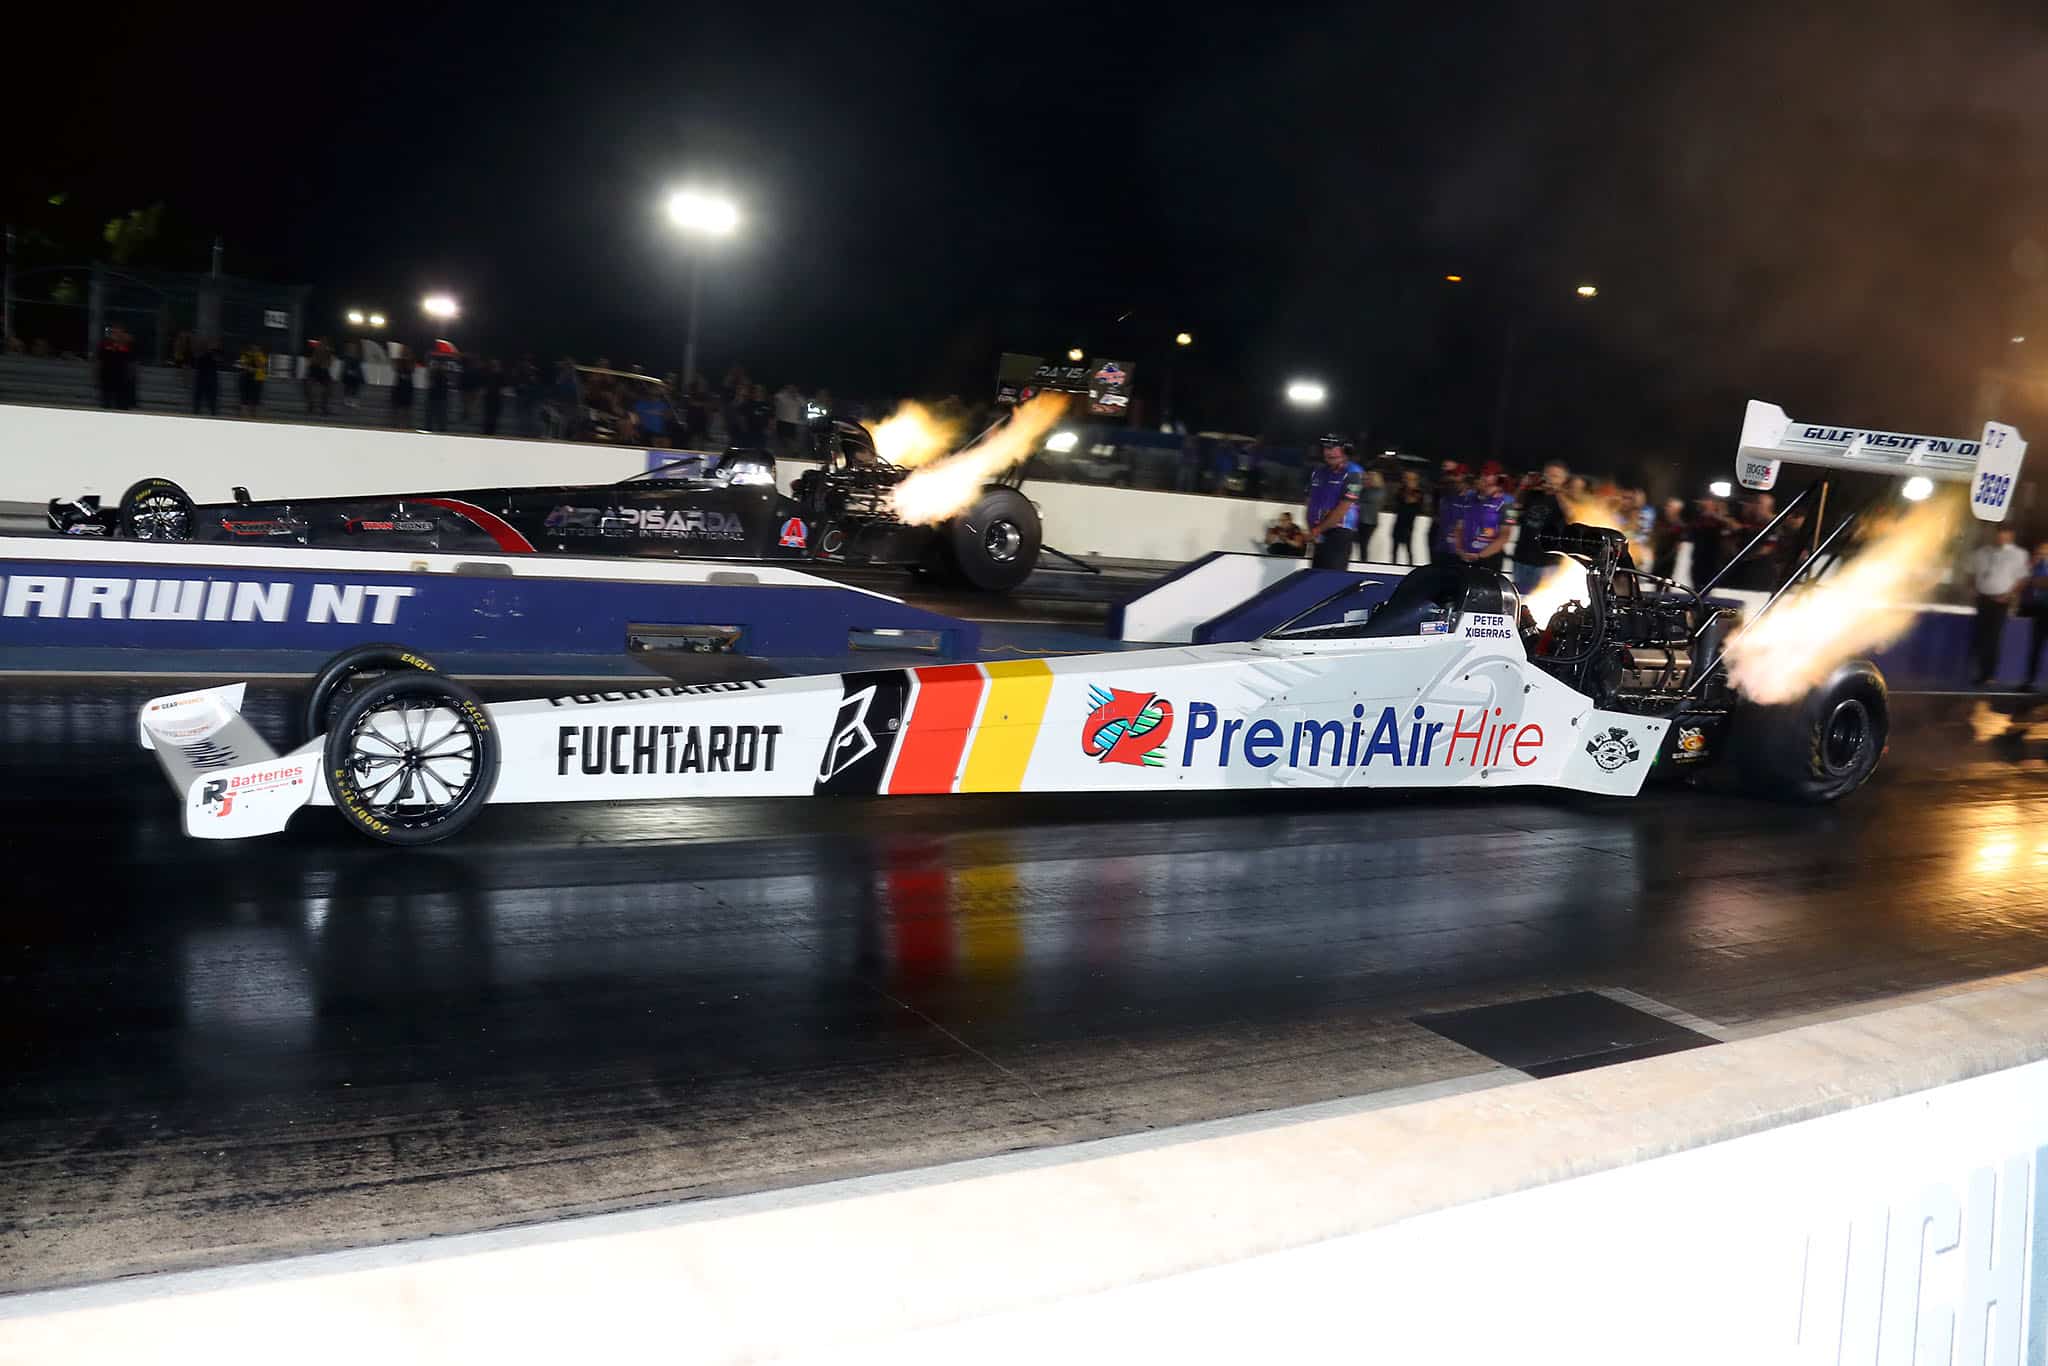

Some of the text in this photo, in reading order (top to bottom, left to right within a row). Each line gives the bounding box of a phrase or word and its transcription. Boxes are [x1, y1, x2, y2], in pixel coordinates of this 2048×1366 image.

[1803, 427, 1853, 442] GULF
[0, 574, 416, 625] ARWIN NT
[1473, 615, 1504, 626] PETER
[1465, 626, 1512, 639] XIBERRAS
[463, 700, 490, 731] EAGLE
[557, 725, 784, 776] FUCHTARDT
[231, 766, 304, 788] Batteries
